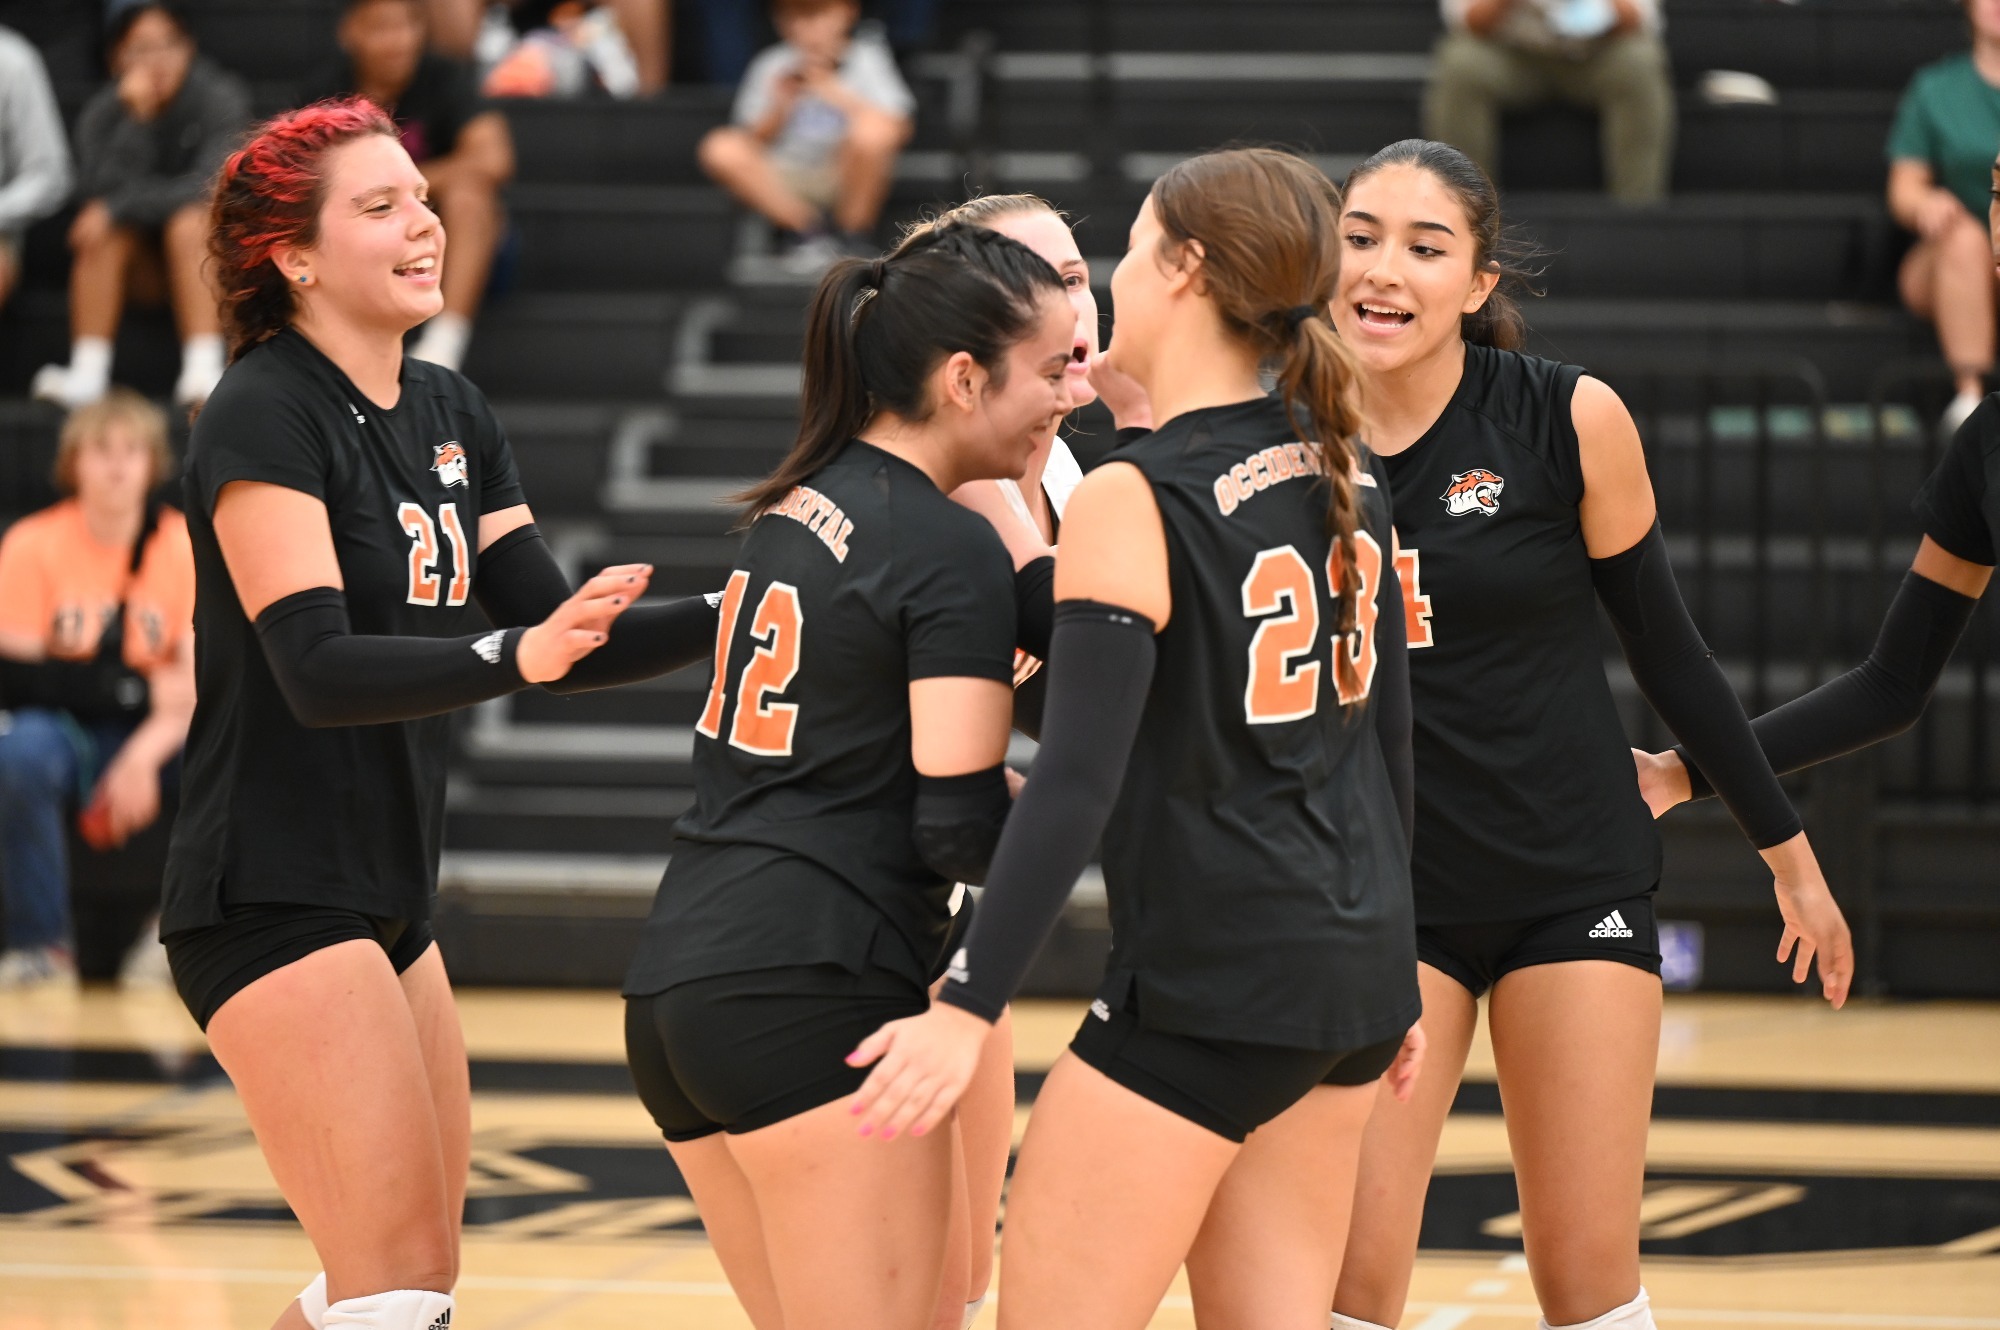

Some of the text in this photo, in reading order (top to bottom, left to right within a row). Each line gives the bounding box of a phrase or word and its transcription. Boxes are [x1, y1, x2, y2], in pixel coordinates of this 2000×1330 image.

[397, 502, 471, 607] 21
[1241, 529, 1382, 725] 23
[695, 569, 804, 756] 12
[1588, 927, 1634, 938] adidas
